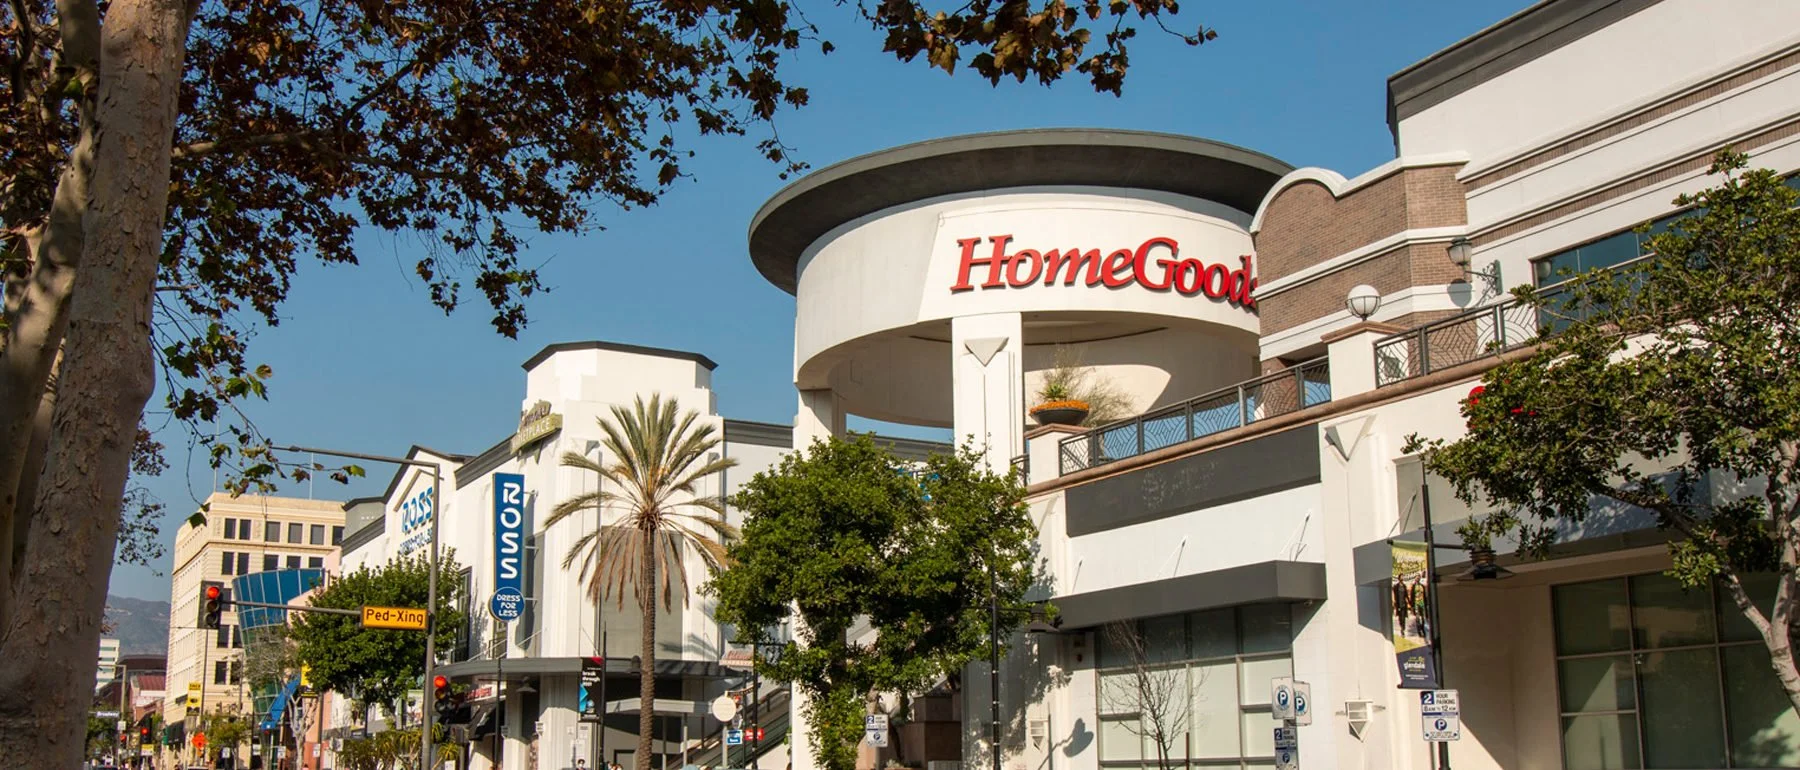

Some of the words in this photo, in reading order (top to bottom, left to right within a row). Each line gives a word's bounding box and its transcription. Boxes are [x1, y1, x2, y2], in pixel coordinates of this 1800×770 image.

[500, 482, 522, 579] ROSS
[496, 594, 521, 602] DRESS
[500, 602, 516, 610] FOR
[366, 608, 424, 626] Ped-Xing
[1423, 693, 1433, 704] 2
